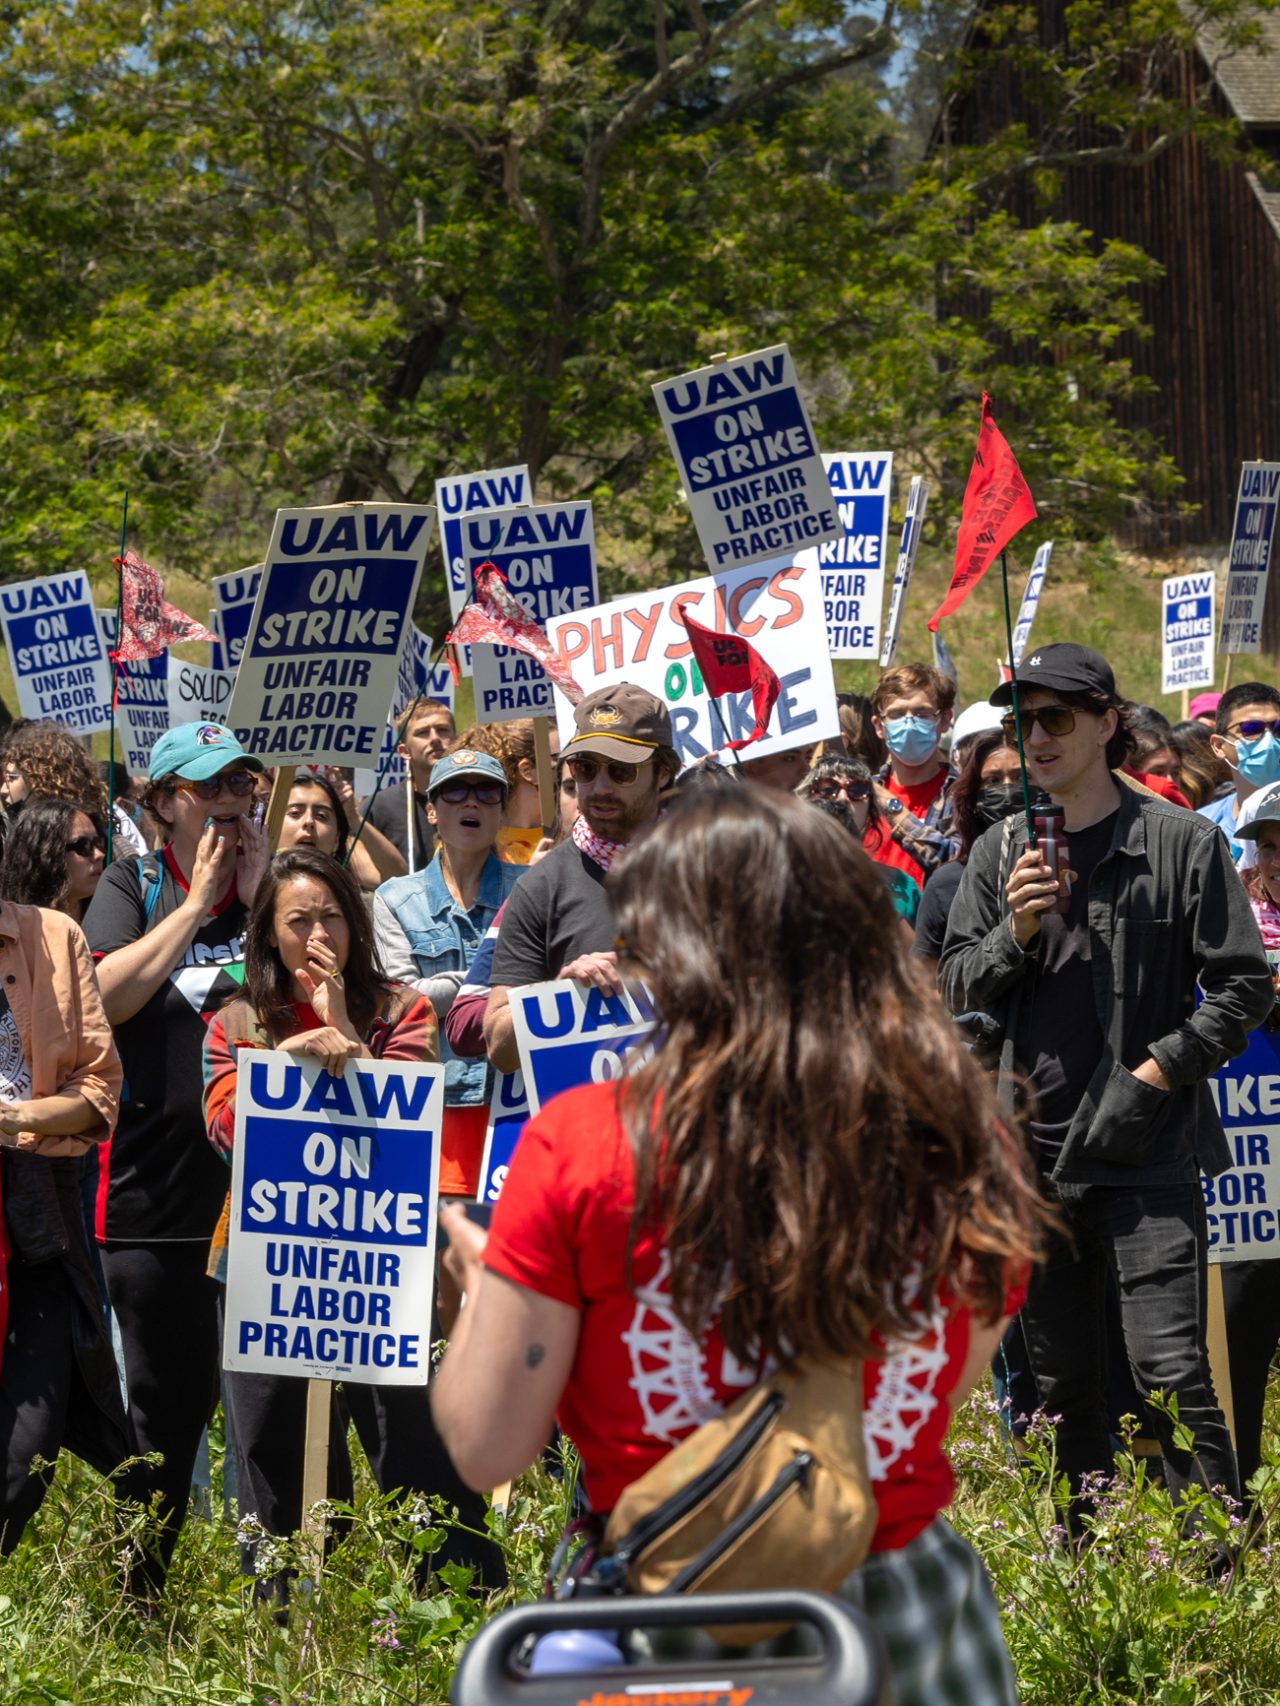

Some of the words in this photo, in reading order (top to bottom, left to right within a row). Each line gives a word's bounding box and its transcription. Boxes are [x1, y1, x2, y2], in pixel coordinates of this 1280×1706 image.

[663, 354, 784, 415] UAW
[714, 404, 764, 441] ON
[690, 426, 809, 483] STRIKE
[713, 467, 807, 511] UNFAIR
[827, 460, 887, 490] AW
[1241, 470, 1280, 498] UAW
[441, 474, 524, 514] UAW
[468, 508, 587, 551] UAW
[724, 492, 810, 535] LABOR
[838, 501, 855, 530] N
[1245, 508, 1262, 535] ON
[279, 514, 428, 556] UAW
[713, 510, 837, 565] PRACTICE
[1231, 540, 1269, 566] STRIKE
[309, 566, 366, 604] ON
[507, 554, 554, 587] ON
[821, 575, 865, 597] FAIR
[1, 577, 84, 614] UAW
[515, 586, 590, 620] RIKE
[1167, 577, 1211, 600] UAW
[35, 613, 68, 640] ON
[556, 566, 807, 676] PHYSICS
[824, 600, 860, 622] BOR
[1178, 601, 1198, 620] ON
[258, 609, 400, 649] STRIKE
[1167, 618, 1211, 642] STRIKE
[17, 634, 99, 671] STRIKE
[1171, 641, 1205, 658] UNFAIR
[1172, 655, 1202, 672] LABOR
[32, 666, 96, 695] UNFAIR
[263, 660, 371, 690] UNFAIR
[499, 659, 547, 683] LAB
[1166, 667, 1210, 687] PRACTICE
[39, 687, 97, 714] LABOR
[117, 677, 168, 702] STRIK
[259, 692, 358, 722] LABOR
[668, 667, 818, 763] RIKE
[233, 724, 376, 755] PRACTICE
[521, 985, 651, 1040] UA
[249, 1062, 435, 1121] UAW
[303, 1132, 372, 1181] ON
[1200, 1172, 1267, 1207] BOR
[247, 1178, 424, 1236] STRIKE
[265, 1242, 401, 1288] UNFAIR
[270, 1283, 391, 1328] LABOR
[238, 1320, 420, 1370] PRACTICE
